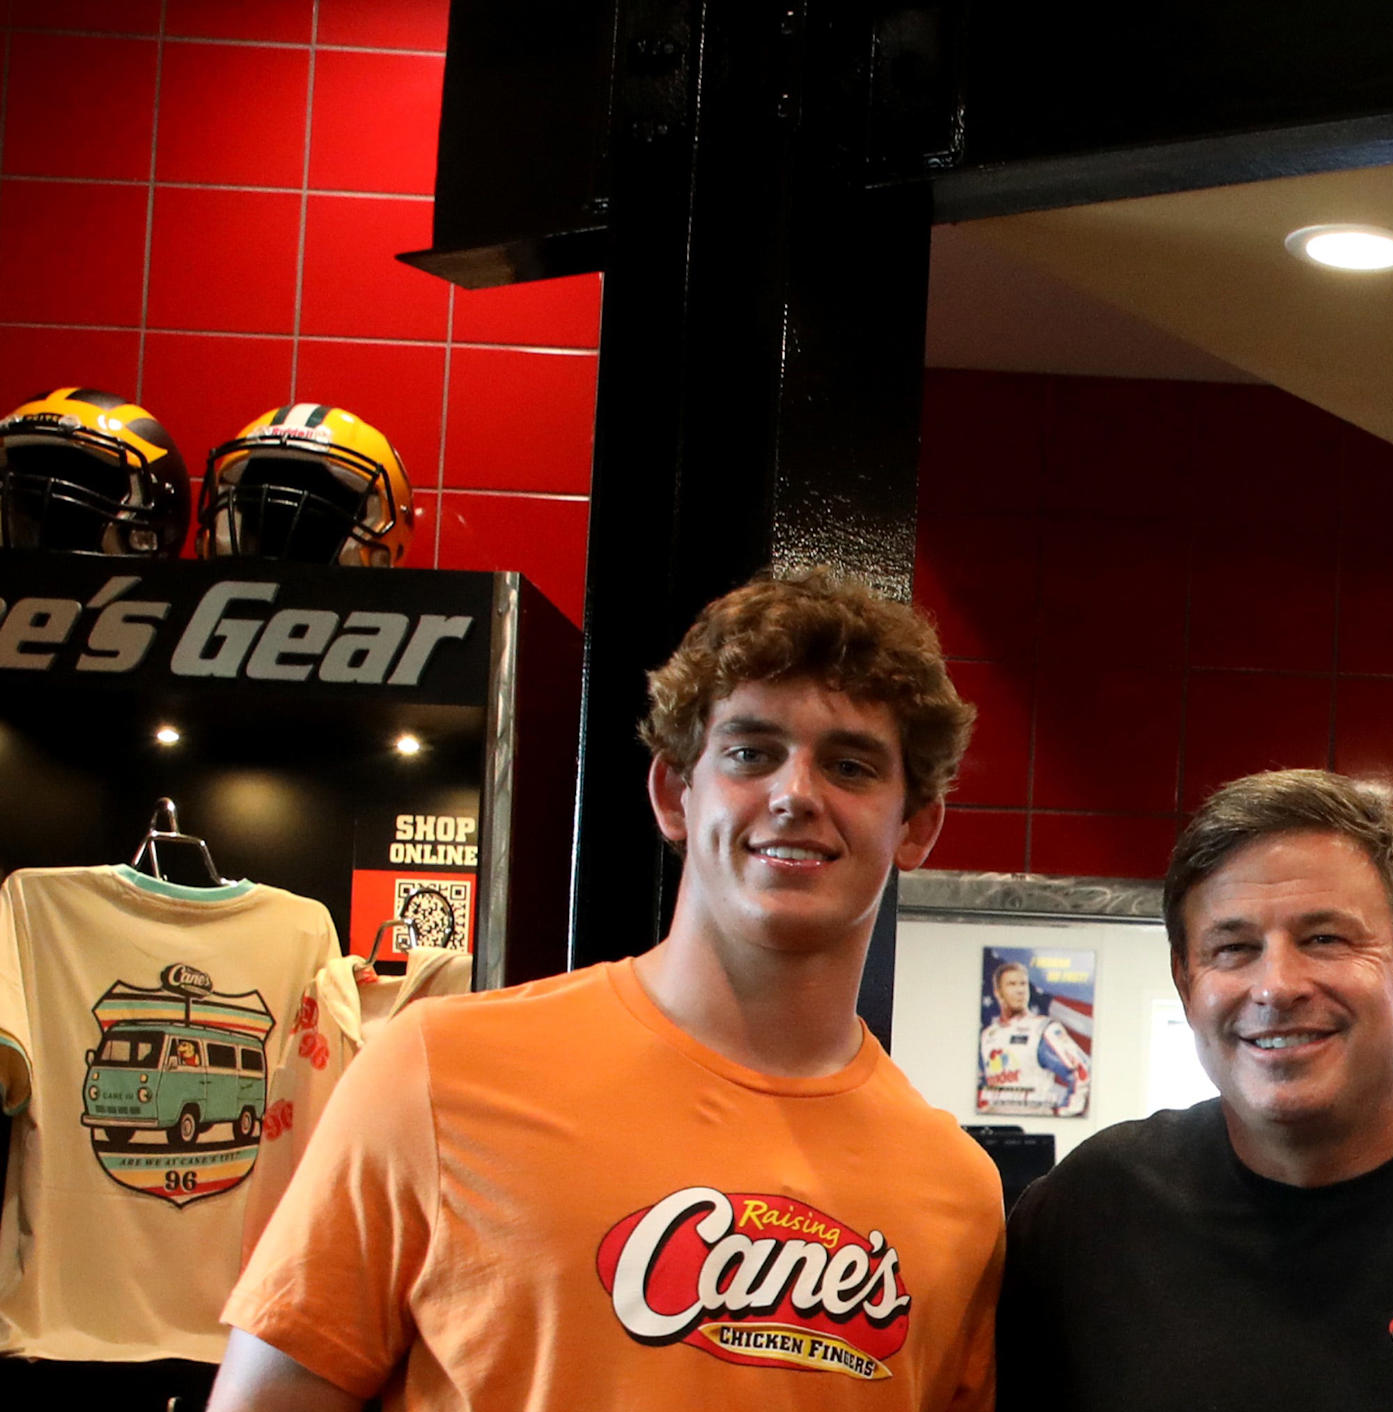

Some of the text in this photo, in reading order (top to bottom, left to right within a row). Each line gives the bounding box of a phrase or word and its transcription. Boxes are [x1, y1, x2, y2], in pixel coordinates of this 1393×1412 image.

[0, 576, 474, 686] e's Gear
[395, 814, 476, 842] SHOP
[389, 842, 479, 867] ONLINE
[167, 963, 211, 988] Cane's
[165, 1170, 199, 1192] 96
[738, 1199, 841, 1249] Raising
[612, 1186, 911, 1341] Cane's
[719, 1326, 876, 1378] CHICKEN FINGERS
